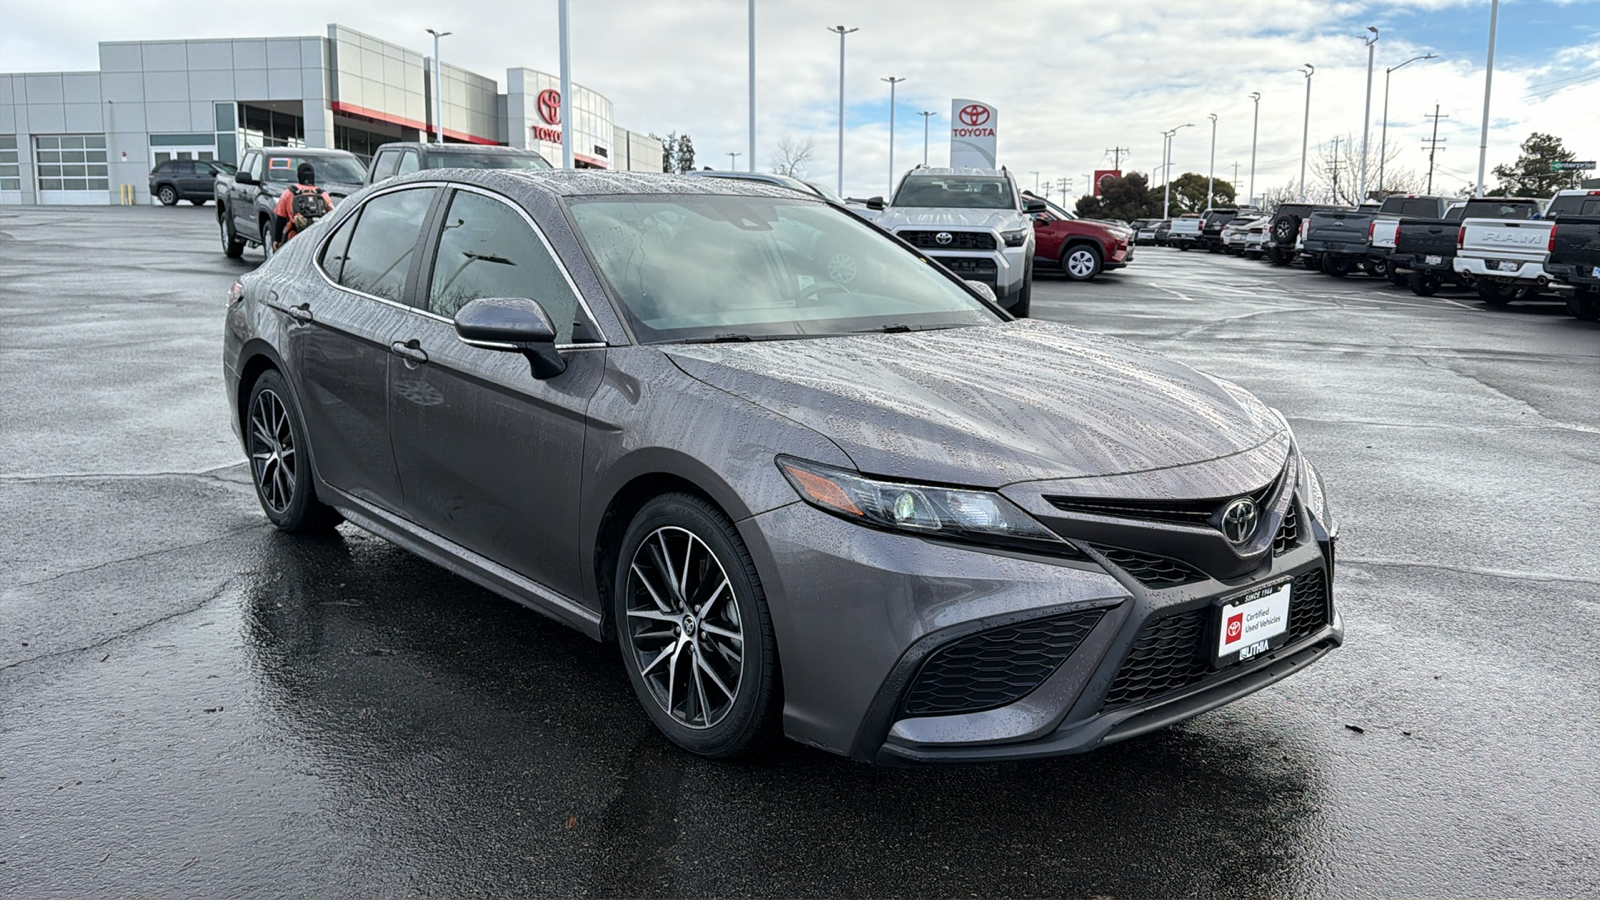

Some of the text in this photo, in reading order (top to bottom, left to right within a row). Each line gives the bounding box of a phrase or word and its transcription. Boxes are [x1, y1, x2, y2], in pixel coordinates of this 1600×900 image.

[952, 128, 995, 137] TOYOTA
[1482, 231, 1543, 245] RAM
[1245, 591, 1261, 603] SINCE
[1246, 607, 1270, 622] Certified
[1245, 615, 1281, 633] Used Vehicles
[1246, 639, 1269, 657] LITHIA
